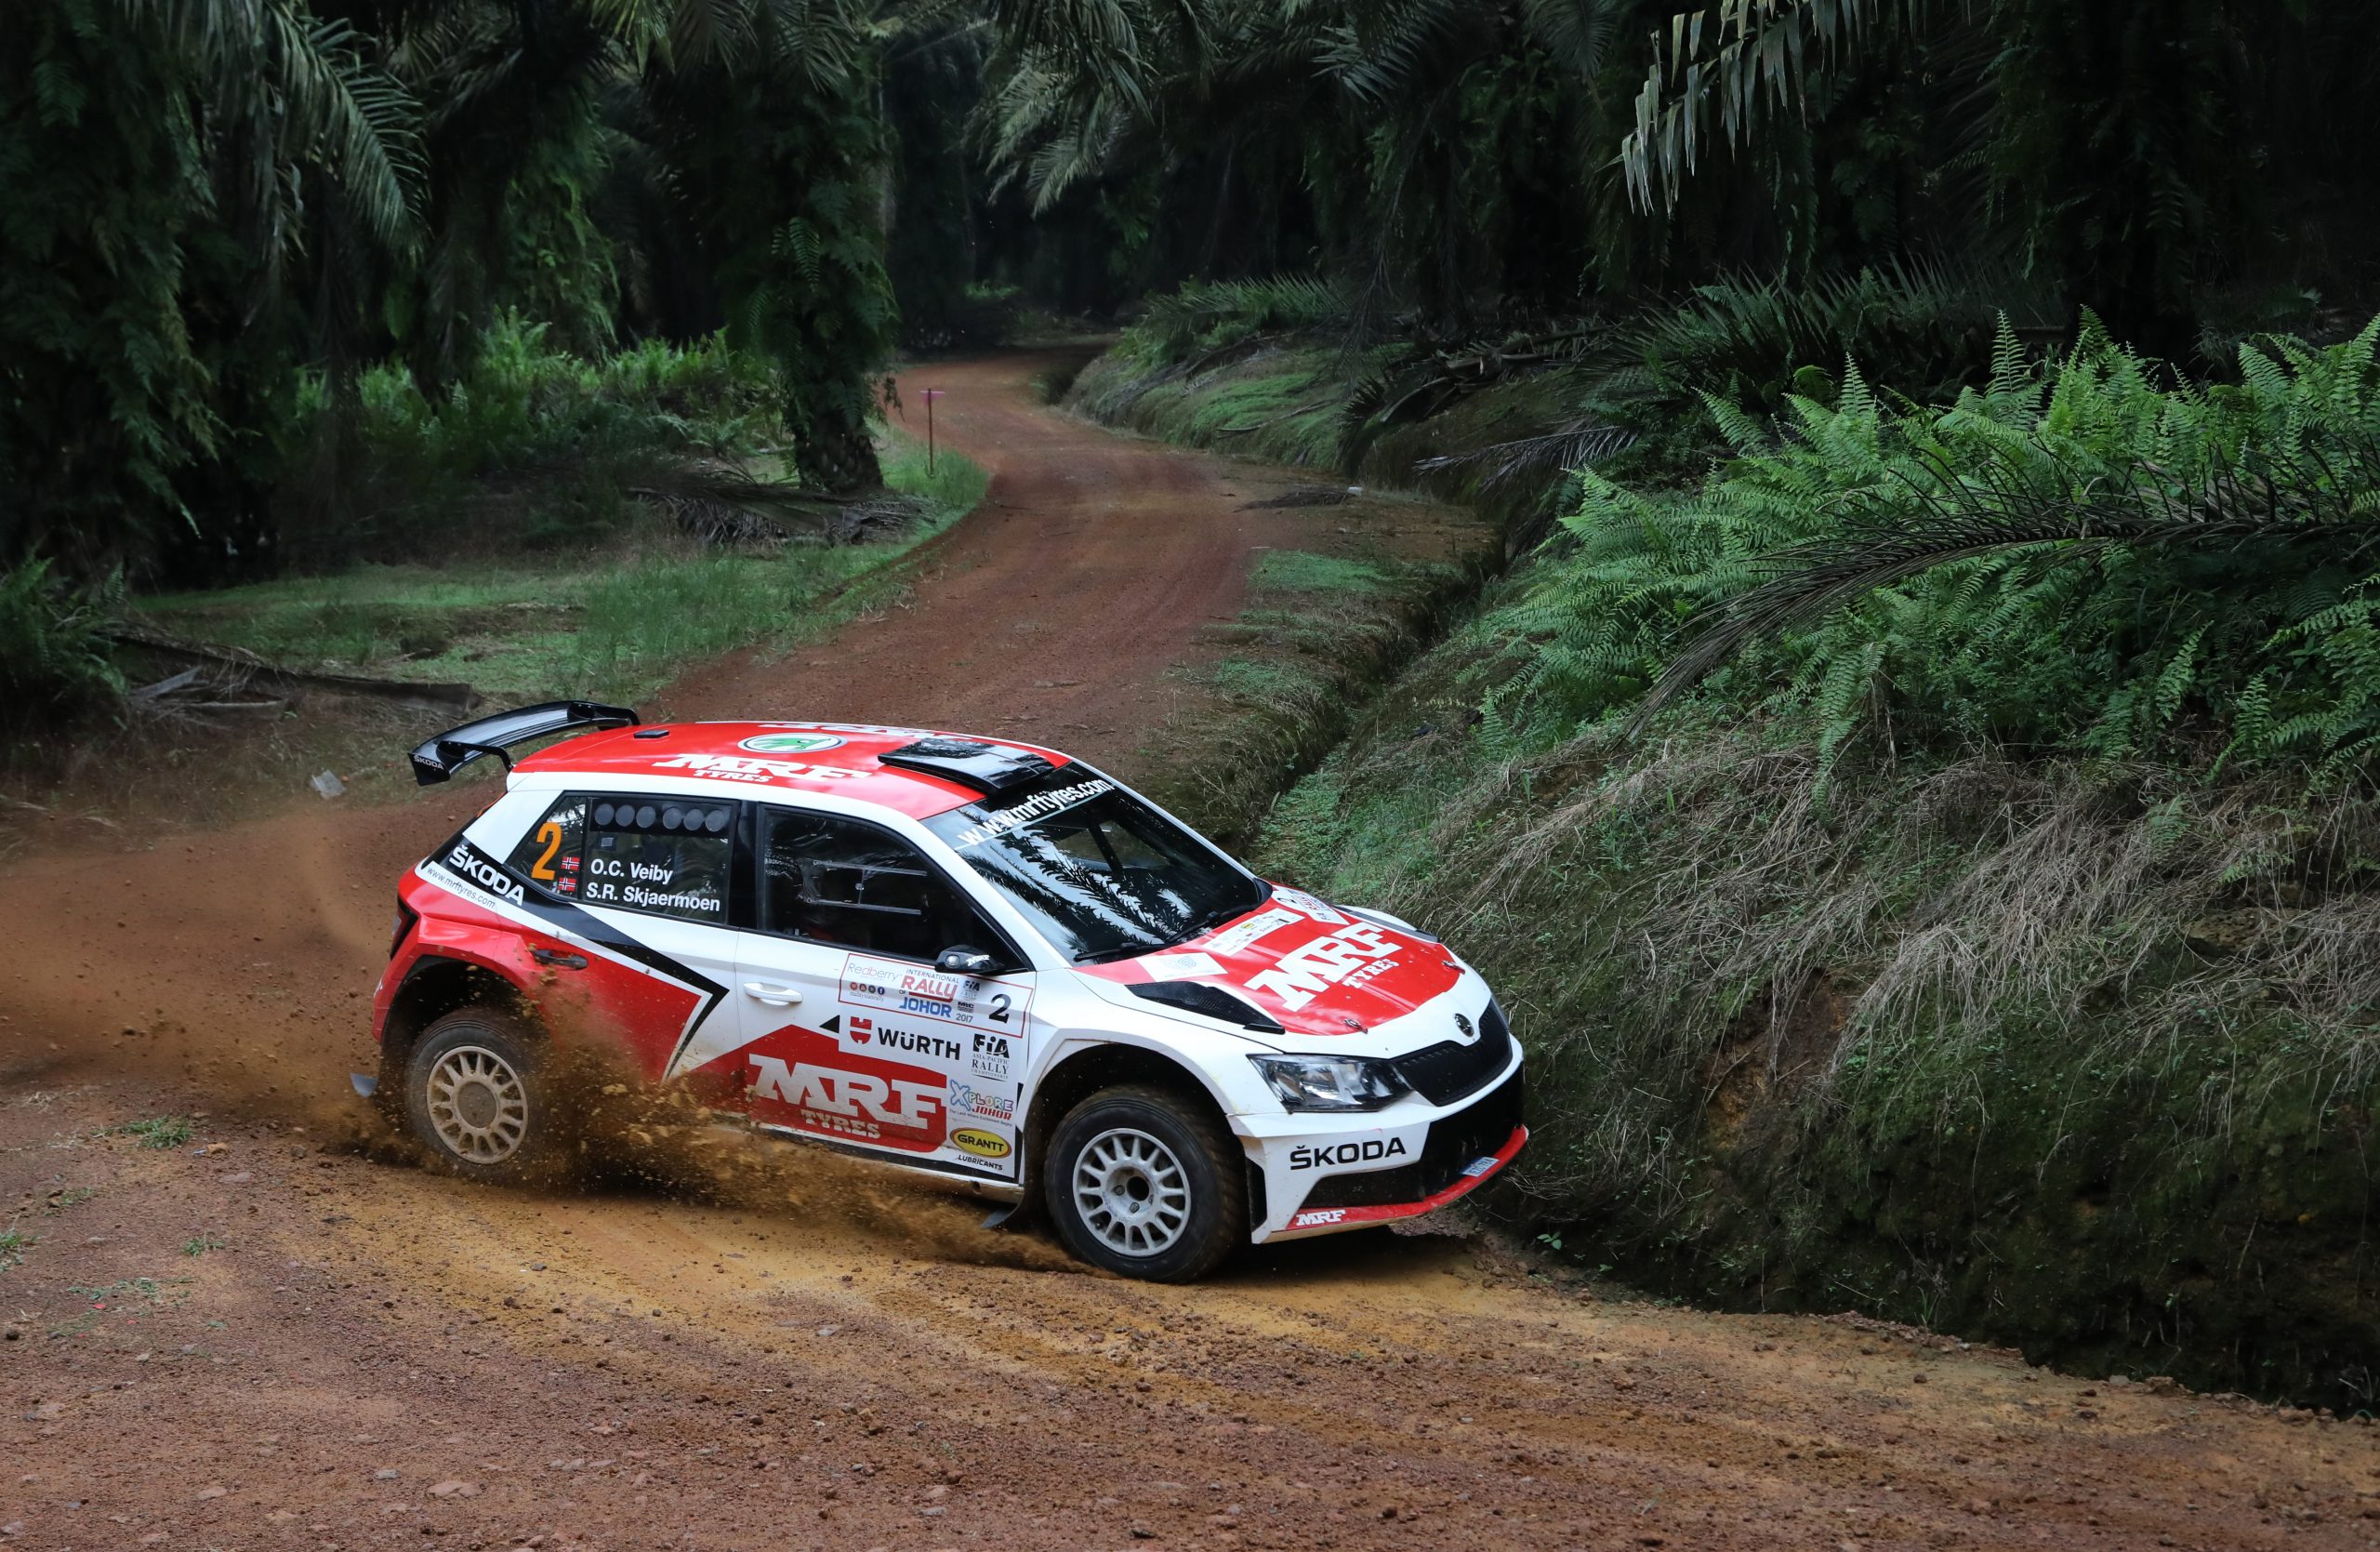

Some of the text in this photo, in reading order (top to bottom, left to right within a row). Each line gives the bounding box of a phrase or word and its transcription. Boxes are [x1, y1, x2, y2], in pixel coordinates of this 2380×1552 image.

[413, 754, 444, 770] ŠKODA
[652, 753, 872, 782] MRF
[694, 770, 774, 783] TYRES
[531, 822, 562, 881] 2
[448, 844, 524, 907] ŠKODA
[590, 858, 673, 884] O.C. Veiby
[427, 866, 496, 908] www.mrftyres.com
[586, 882, 721, 911] S.R. Skjaermoen
[847, 962, 899, 982] Redberry
[906, 968, 959, 983] INTERNATIONAL
[1243, 922, 1403, 1012] MRF
[1342, 958, 1400, 988] TYRES
[901, 975, 959, 1001] RALLY
[899, 996, 953, 1018] JOHOR
[956, 1013, 973, 1023] 2017
[988, 993, 1012, 1024] 2
[972, 1059, 1010, 1075] RALLY
[748, 1054, 946, 1131] MRF
[950, 1079, 1013, 1111] XPLORE
[800, 1108, 881, 1140] TYRES
[972, 1106, 1012, 1121] JOHOR
[958, 1134, 1004, 1152] GRANTT
[1289, 1137, 1407, 1171] ŠKODA
[958, 1154, 1003, 1171] LUBRICANTS
[1296, 1210, 1346, 1226] MRF
